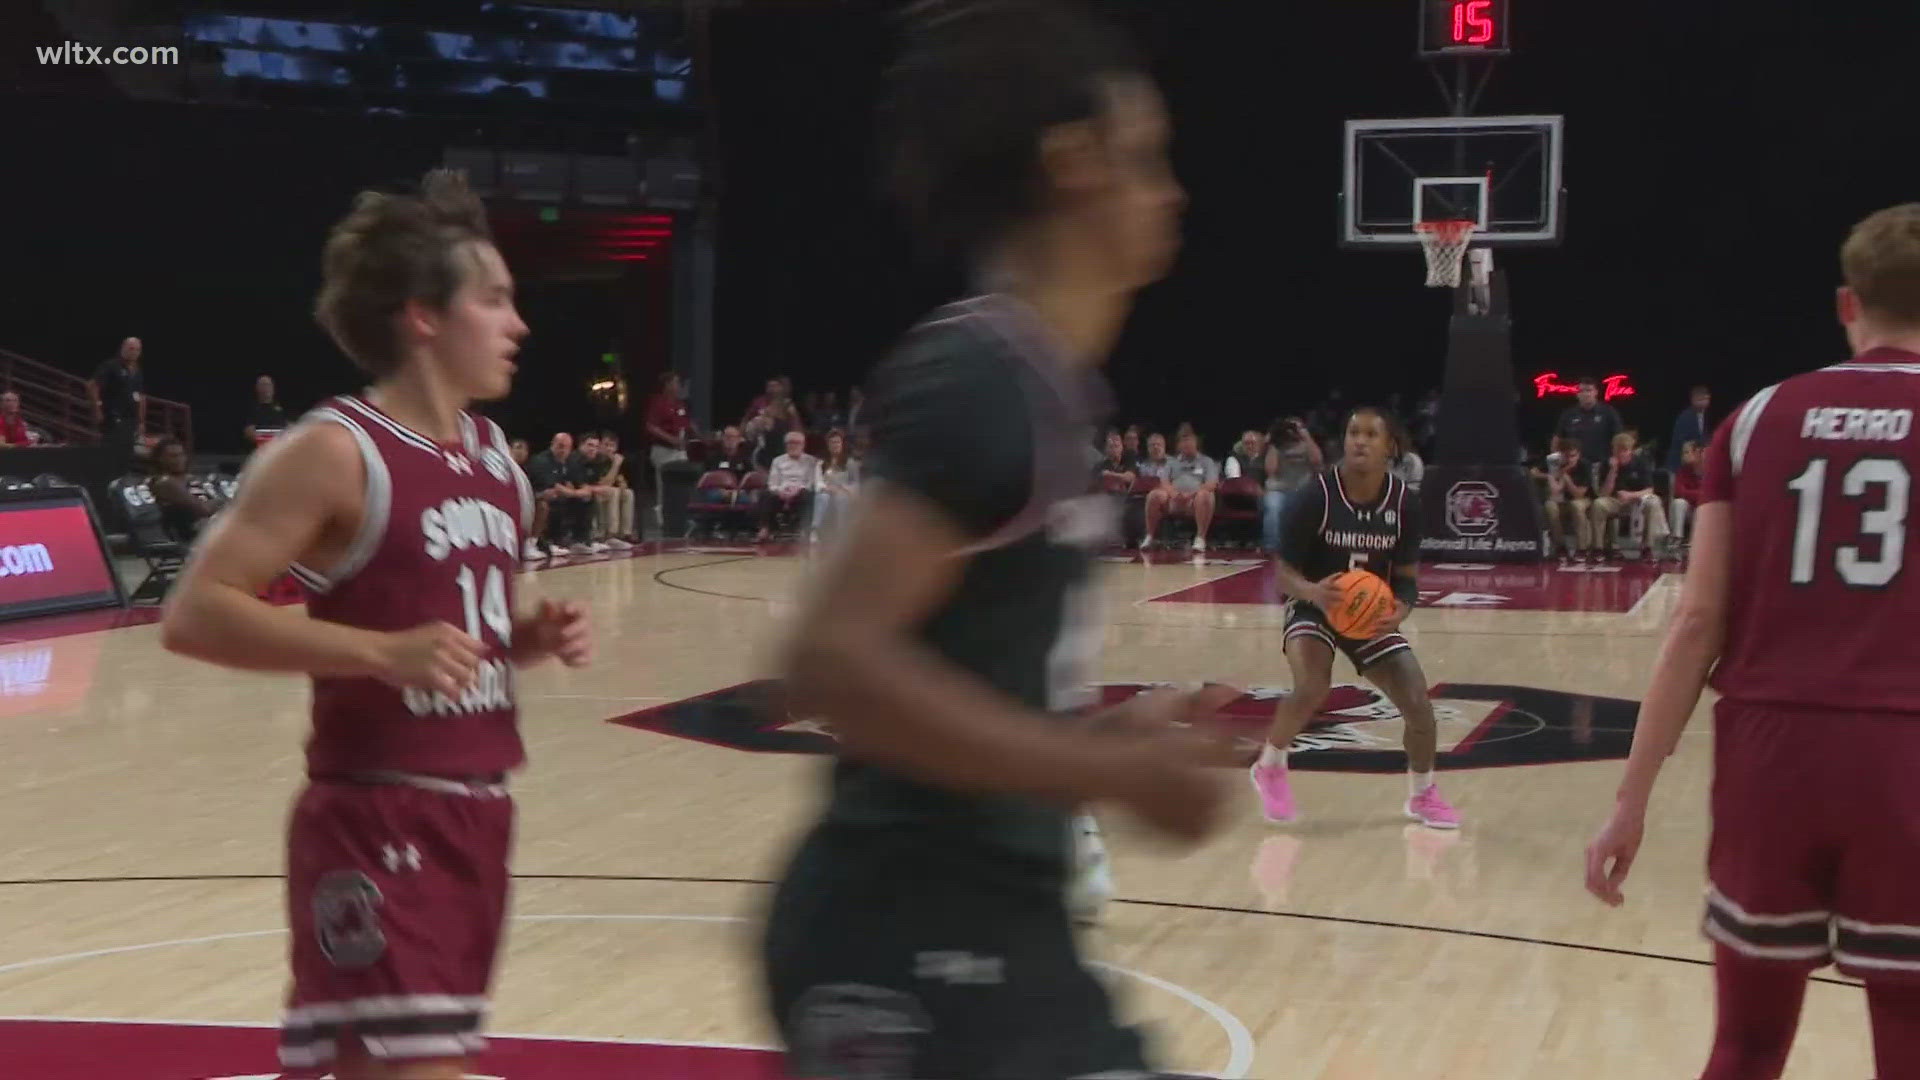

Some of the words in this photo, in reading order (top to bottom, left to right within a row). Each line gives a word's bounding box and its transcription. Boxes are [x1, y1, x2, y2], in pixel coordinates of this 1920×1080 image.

[1453, 0, 1492, 43] 15
[1801, 407, 1913, 441] HERRO
[1325, 530, 1397, 550] GAMECOCKS
[1788, 458, 1911, 586] 13
[1468, 538, 1493, 551] Life
[1494, 538, 1537, 552] Arena
[456, 564, 512, 648] 14
